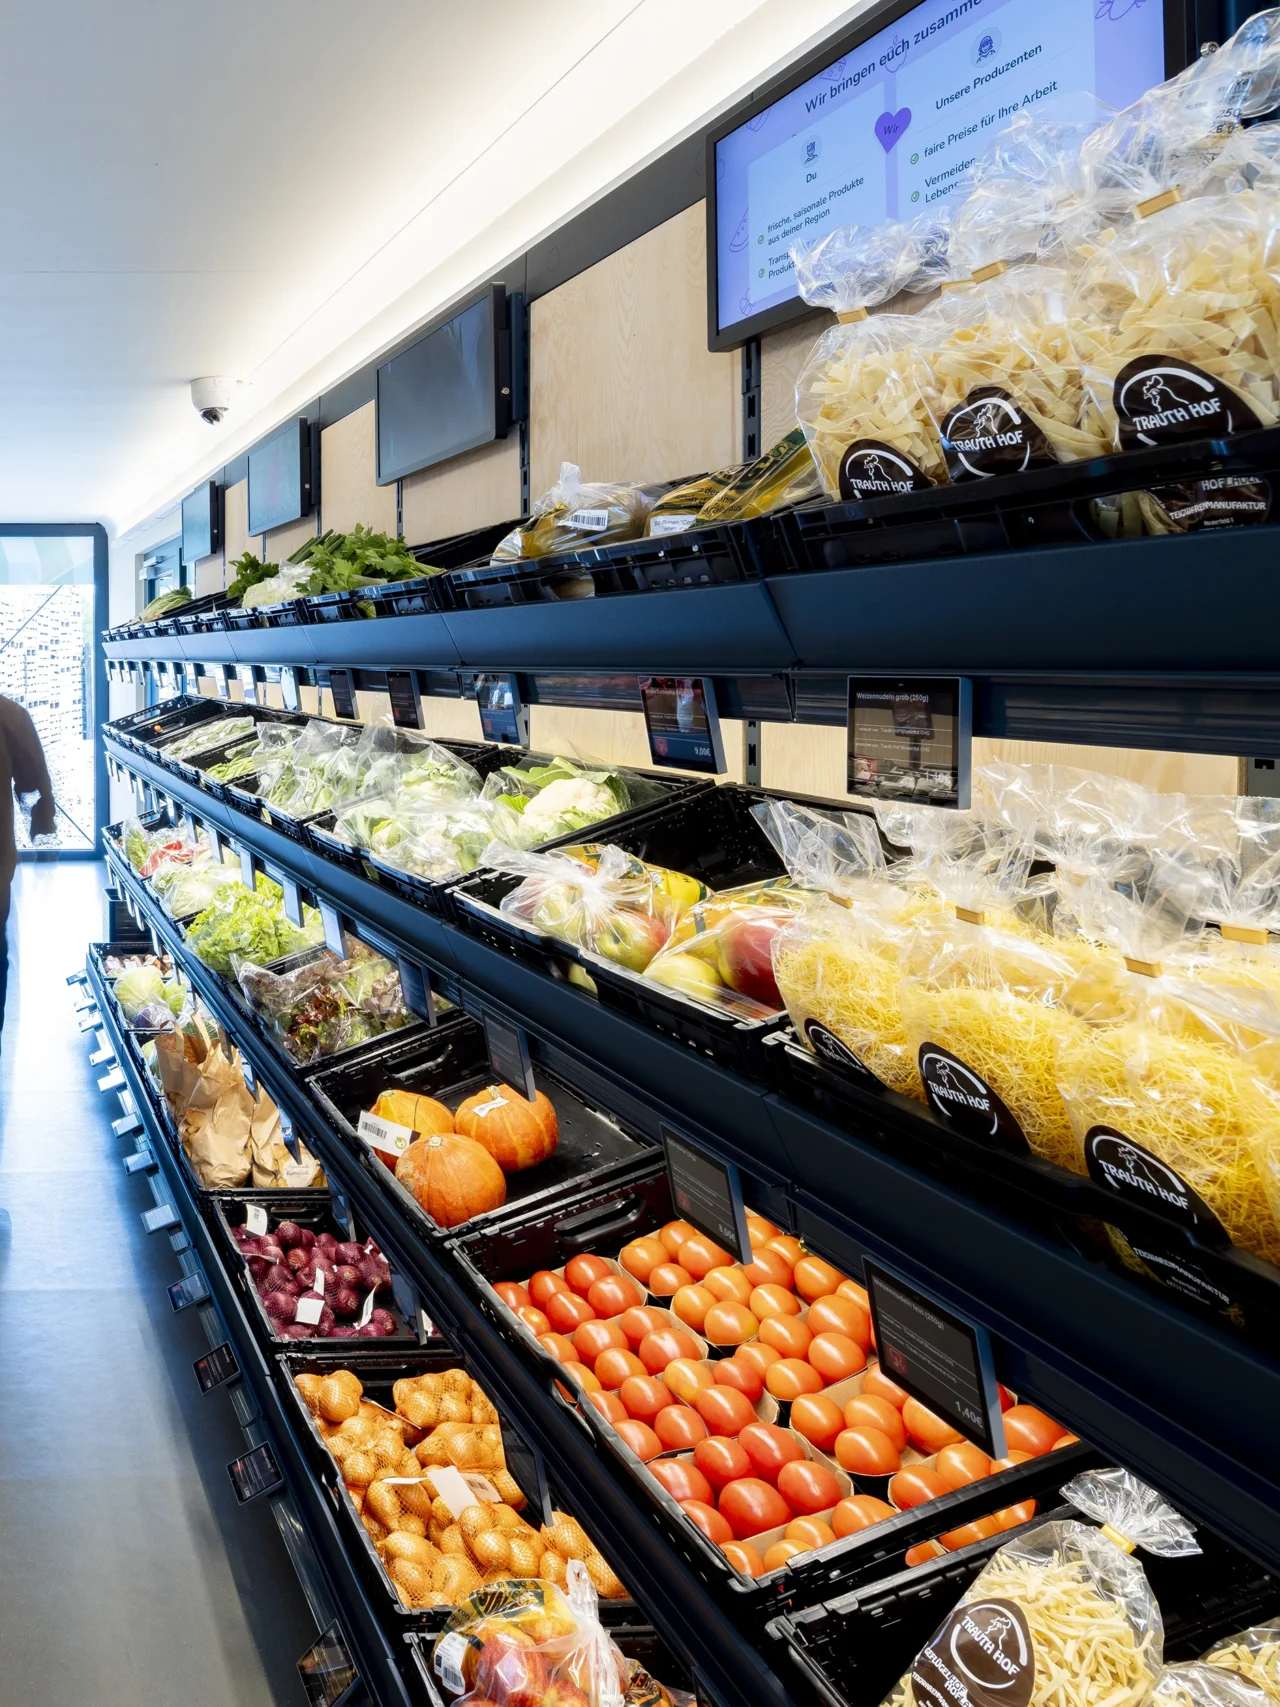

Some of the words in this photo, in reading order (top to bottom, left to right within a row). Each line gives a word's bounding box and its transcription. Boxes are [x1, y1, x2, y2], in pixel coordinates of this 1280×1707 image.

[805, 93, 826, 113] Wir
[830, 62, 875, 99] bringen
[880, 39, 910, 66] euch
[935, 85, 971, 110] Unsere
[973, 44, 1042, 89] Produzenten
[883, 124, 900, 136] Wir
[923, 140, 945, 157] faire
[947, 123, 978, 145] Preise
[980, 114, 995, 128] für
[998, 102, 1019, 119] Ihre
[1022, 80, 1058, 107] Arbeit
[806, 172, 817, 183] Du
[793, 197, 827, 220] saisonale
[828, 177, 864, 201] Produkte
[768, 235, 779, 246] aus
[781, 221, 804, 239] deiner
[804, 207, 831, 227] Region
[768, 250, 791, 267] Transp
[768, 261, 796, 279] Produkt
[1132, 409, 1189, 431] TRAUTH
[1191, 398, 1221, 418] HOF
[951, 436, 995, 453] TRAUTH
[996, 430, 1023, 447] HOF
[850, 478, 890, 492] TRAUTH
[891, 481, 914, 493] HOF
[1169, 501, 1266, 520] TEIGWARENMANUFAKTUR
[856, 692, 895, 700] Weizennudeln
[895, 694, 910, 702] grob
[910, 694, 929, 702] (250g)
[928, 1081, 966, 1105] TRAUTH
[968, 1095, 990, 1112] HOF
[1098, 1160, 1156, 1196] TRAUTH
[1157, 1186, 1189, 1210] HOF
[872, 1276, 912, 1307] Weizennudeln
[912, 1303, 925, 1317] fein
[924, 1311, 944, 1330] (250g)
[955, 1401, 984, 1428] 1,40€
[961, 1615, 995, 1655] TRAUTH
[992, 1649, 1020, 1676] HOF
[924, 1647, 968, 1693] GEFLÜGELHOF
[944, 1681, 975, 1707] HOFLA
